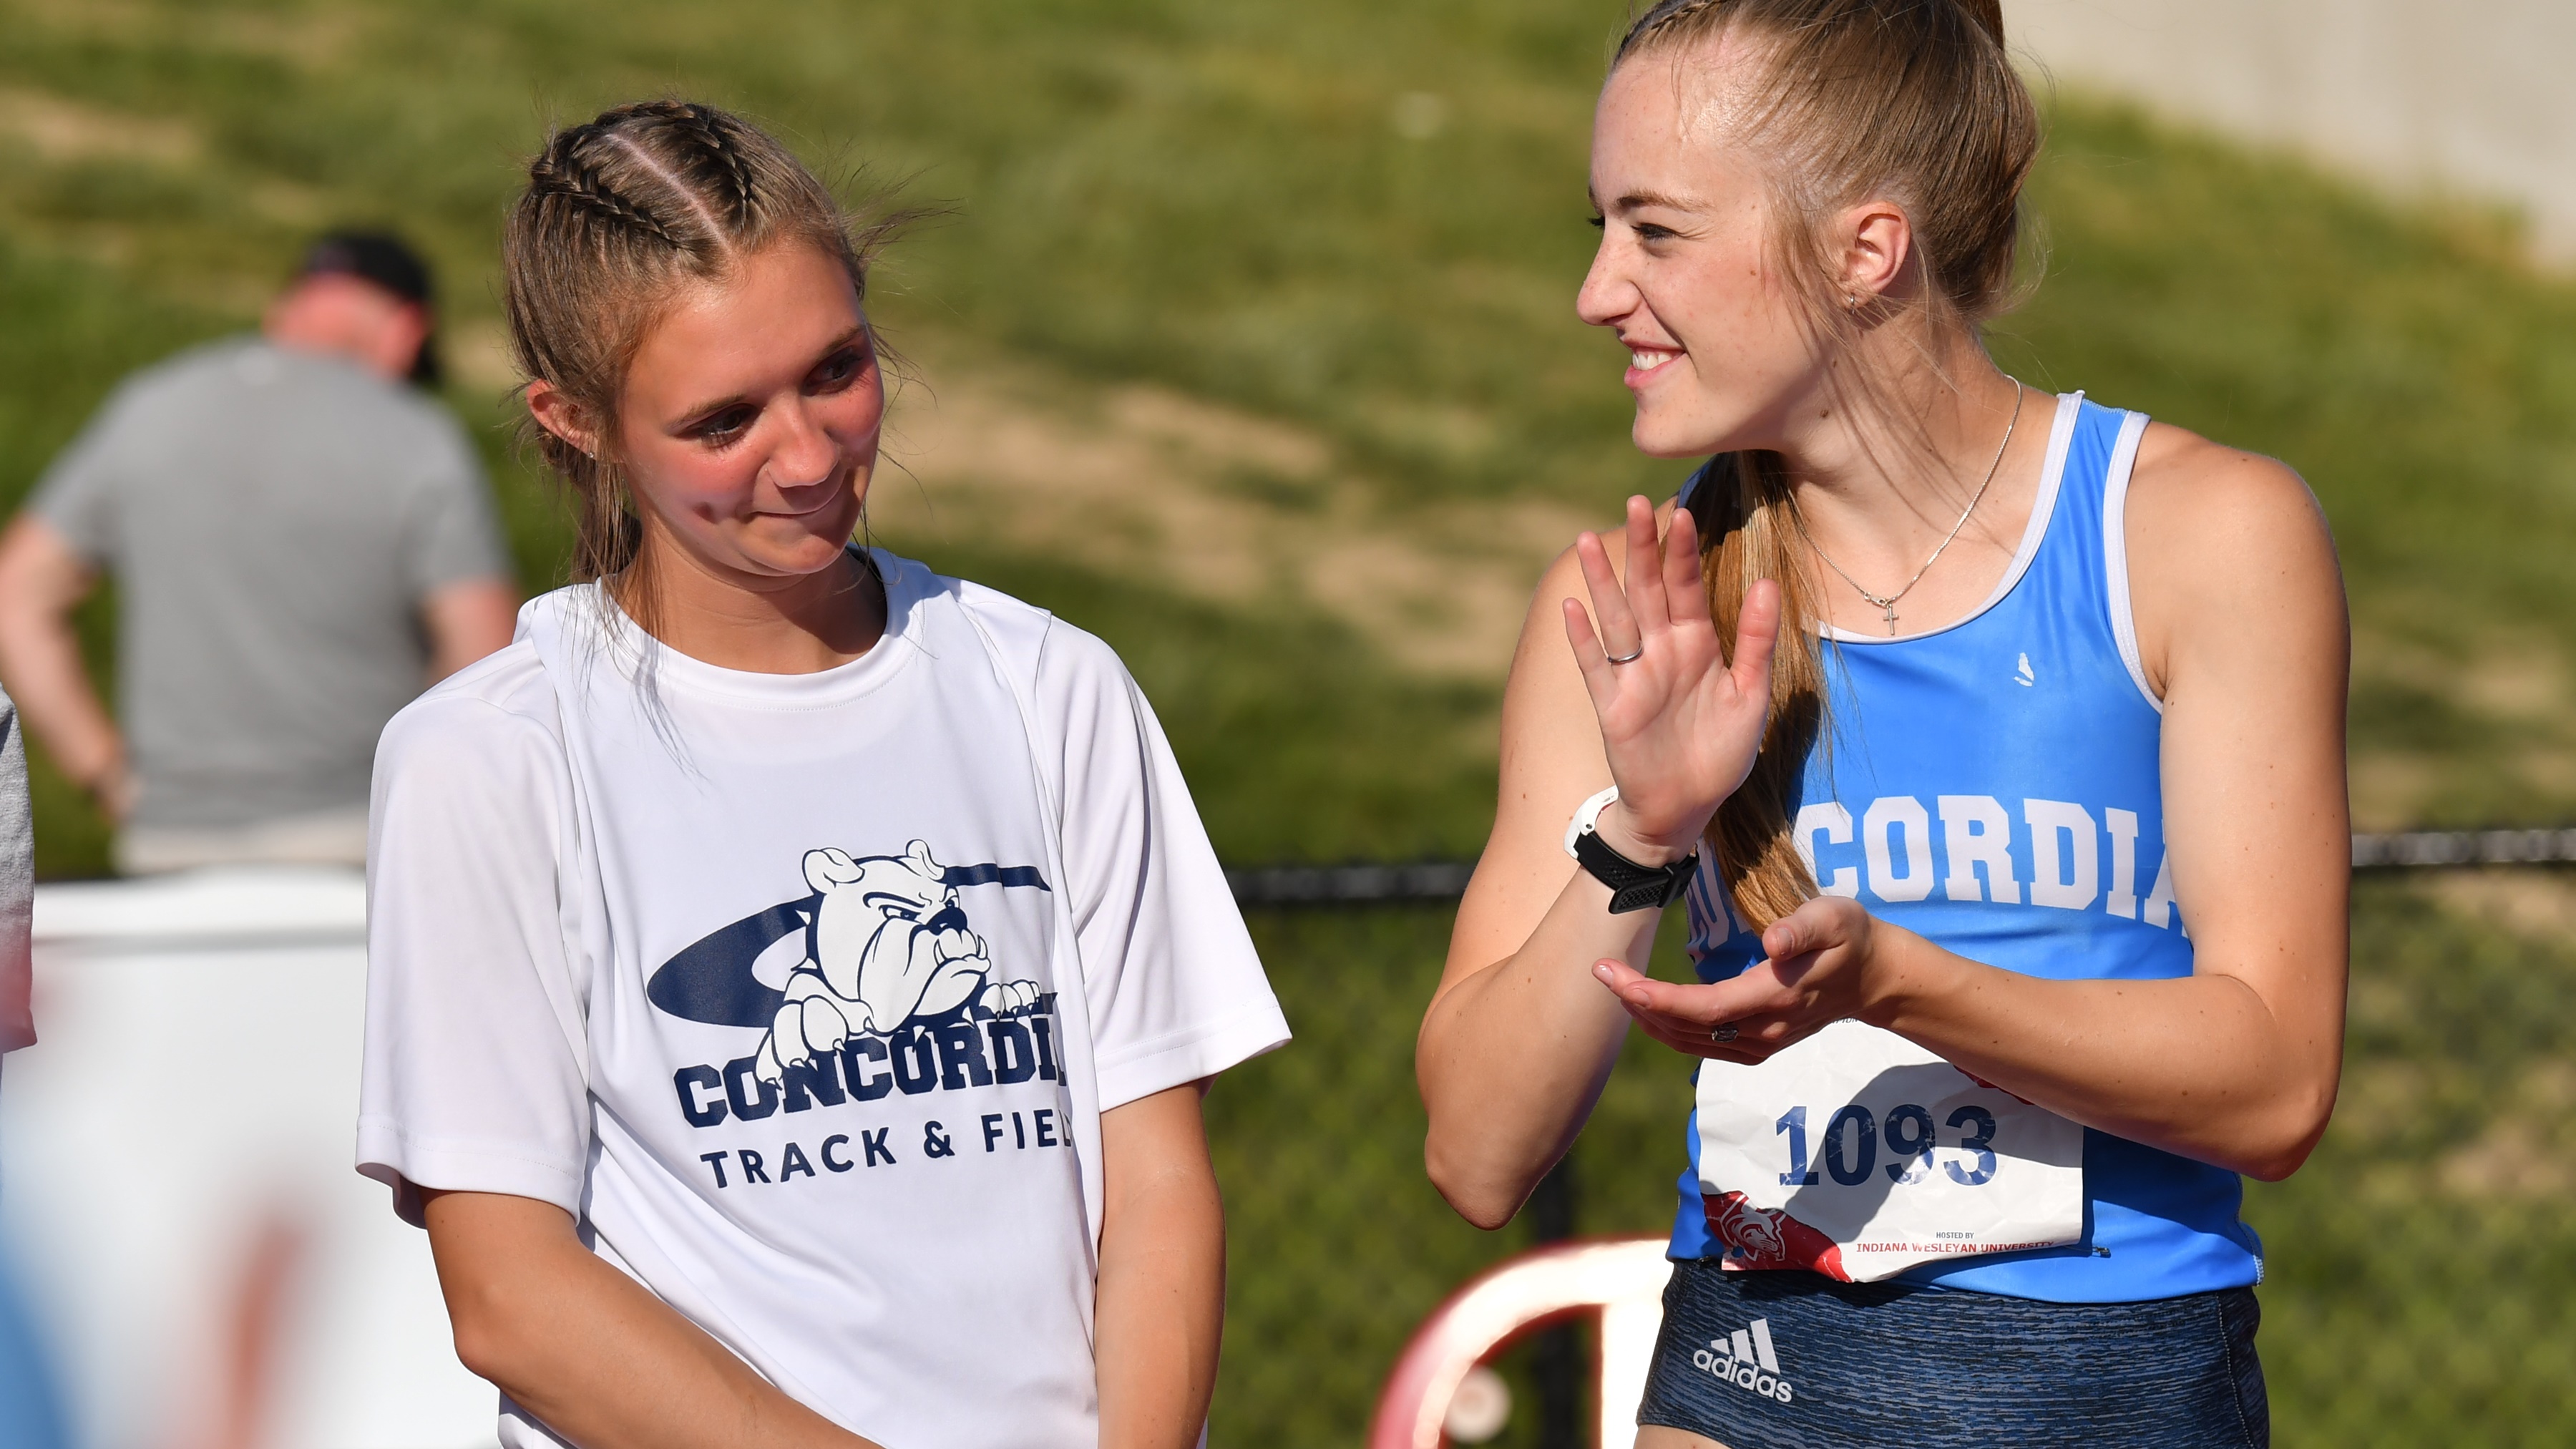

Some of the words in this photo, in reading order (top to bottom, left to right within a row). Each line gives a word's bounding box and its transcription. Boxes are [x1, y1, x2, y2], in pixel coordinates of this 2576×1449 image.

[673, 1018, 1067, 1128] CONCORDI
[700, 1126, 897, 1189] TRACK
[924, 1120, 955, 1158] &
[1775, 1104, 1997, 1186] 1093
[1856, 1242, 1908, 1253] INDIANA
[1911, 1242, 1976, 1253] WESLEYAN
[1981, 1241, 2054, 1253] UNIVERSITY
[1693, 1349, 1793, 1403] adidas
